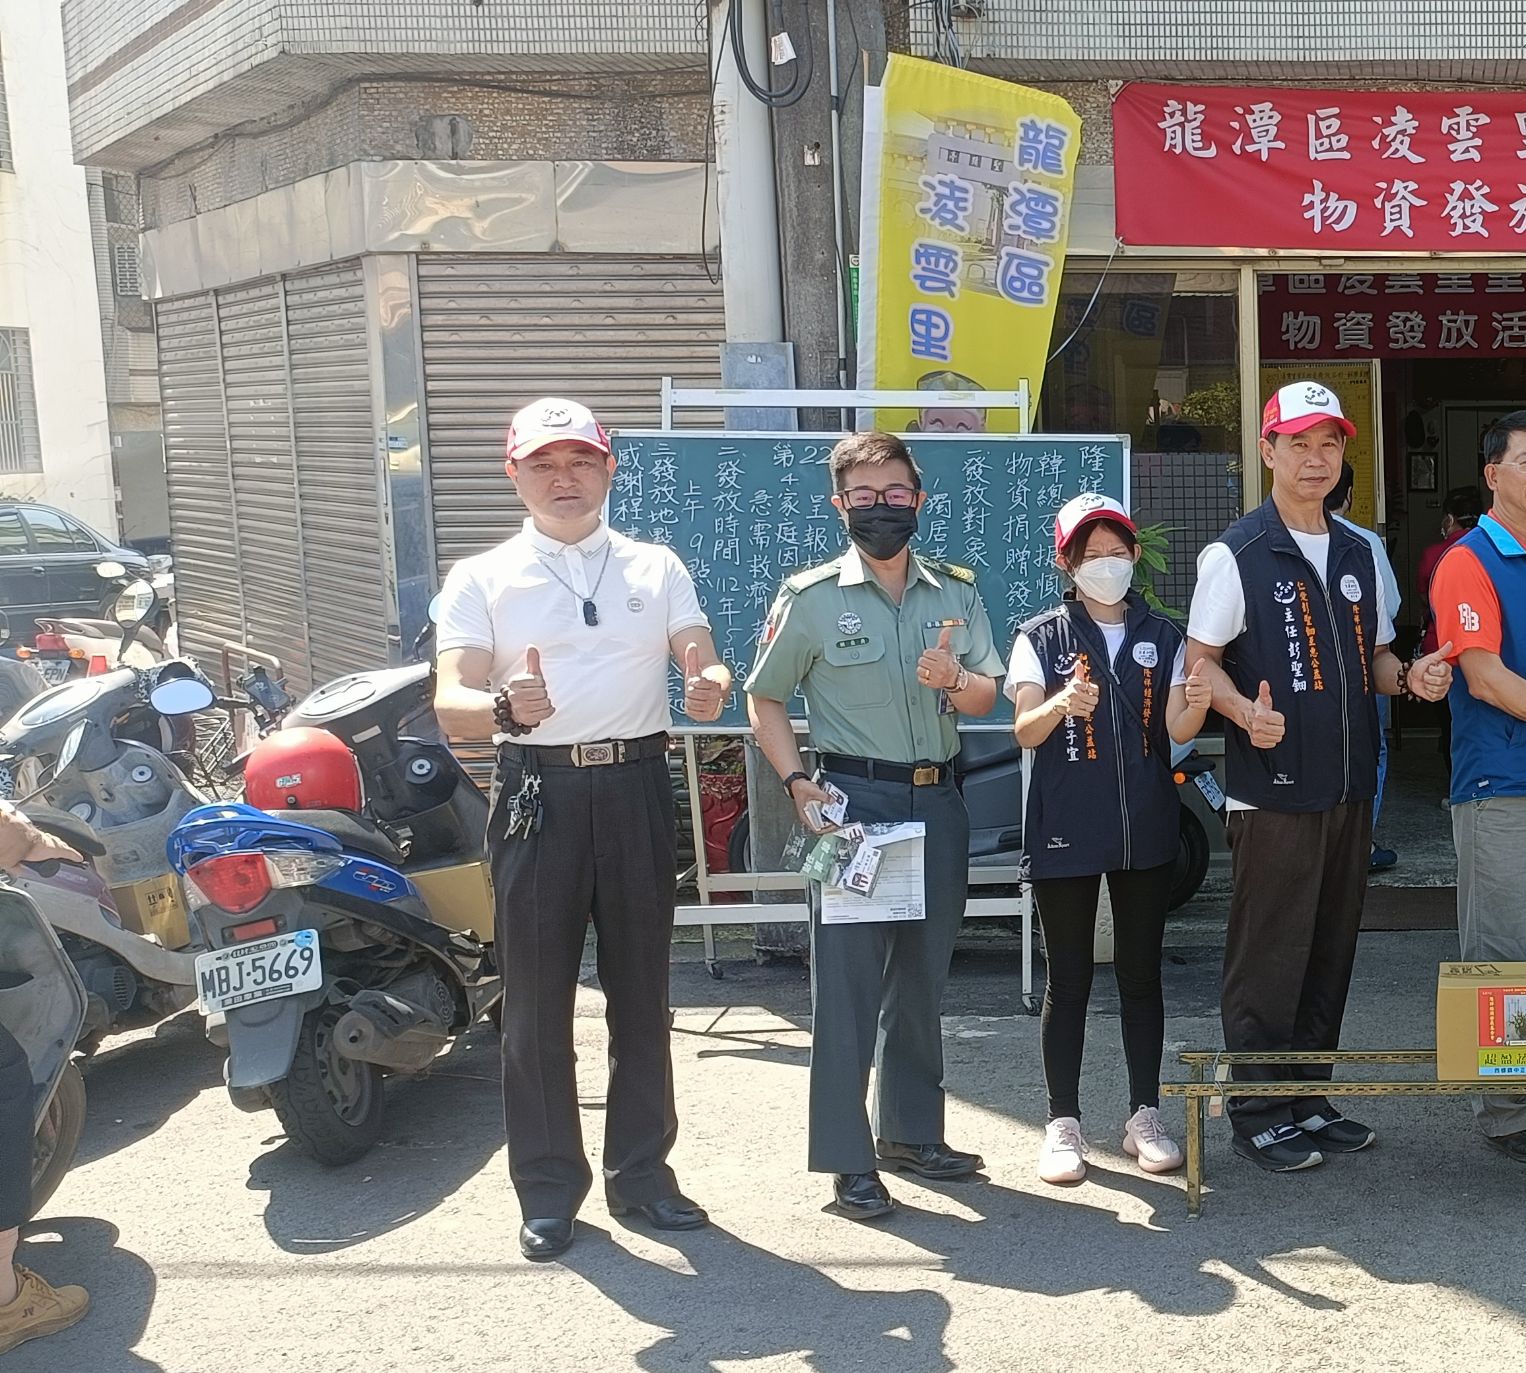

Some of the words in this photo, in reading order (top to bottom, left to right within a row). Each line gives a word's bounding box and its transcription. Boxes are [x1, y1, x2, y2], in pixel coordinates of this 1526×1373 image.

[911, 178, 971, 361] 凌雲里
[1001, 118, 1068, 304] 龍潭區
